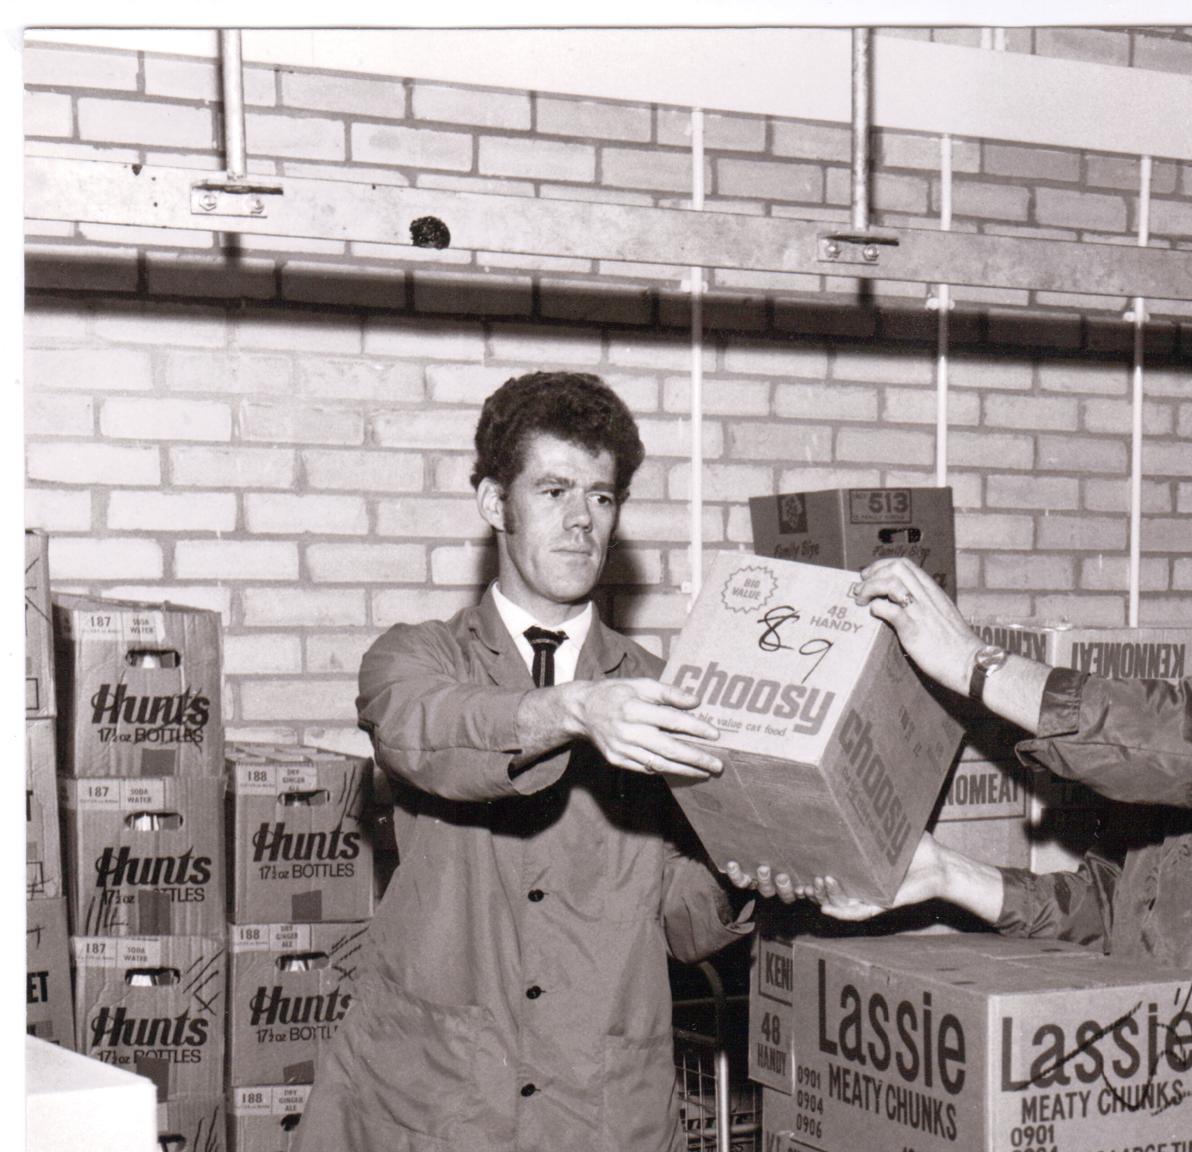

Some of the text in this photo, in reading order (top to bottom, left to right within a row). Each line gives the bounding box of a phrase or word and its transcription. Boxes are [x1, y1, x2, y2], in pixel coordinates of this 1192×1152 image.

[868, 492, 909, 513] 513
[744, 578, 761, 590] BIG
[731, 588, 761, 601] VALUE
[827, 605, 847, 619] 48
[90, 615, 111, 627] 187
[810, 616, 864, 634] HANDY
[1072, 642, 1186, 679] KENNOMEAT
[91, 683, 210, 726] Hunts
[672, 661, 836, 736] choosy
[135, 727, 203, 743] BOTTLES
[764, 725, 787, 738] food
[248, 770, 267, 782] 188
[89, 786, 110, 797] 187
[252, 822, 361, 863] Hunts
[95, 845, 212, 887] Hunts
[291, 863, 355, 879] BOTTLES
[240, 927, 260, 940] 188
[85, 942, 106, 954] 187
[91, 1005, 209, 1047] Hunts
[818, 959, 966, 1095] Lassie
[242, 1091, 262, 1103] 188
[828, 1063, 957, 1141] MEATY CHUNKS
[1021, 1080, 1184, 1124] MEATY CHUNKS
[1011, 1125, 1055, 1148] 0901
